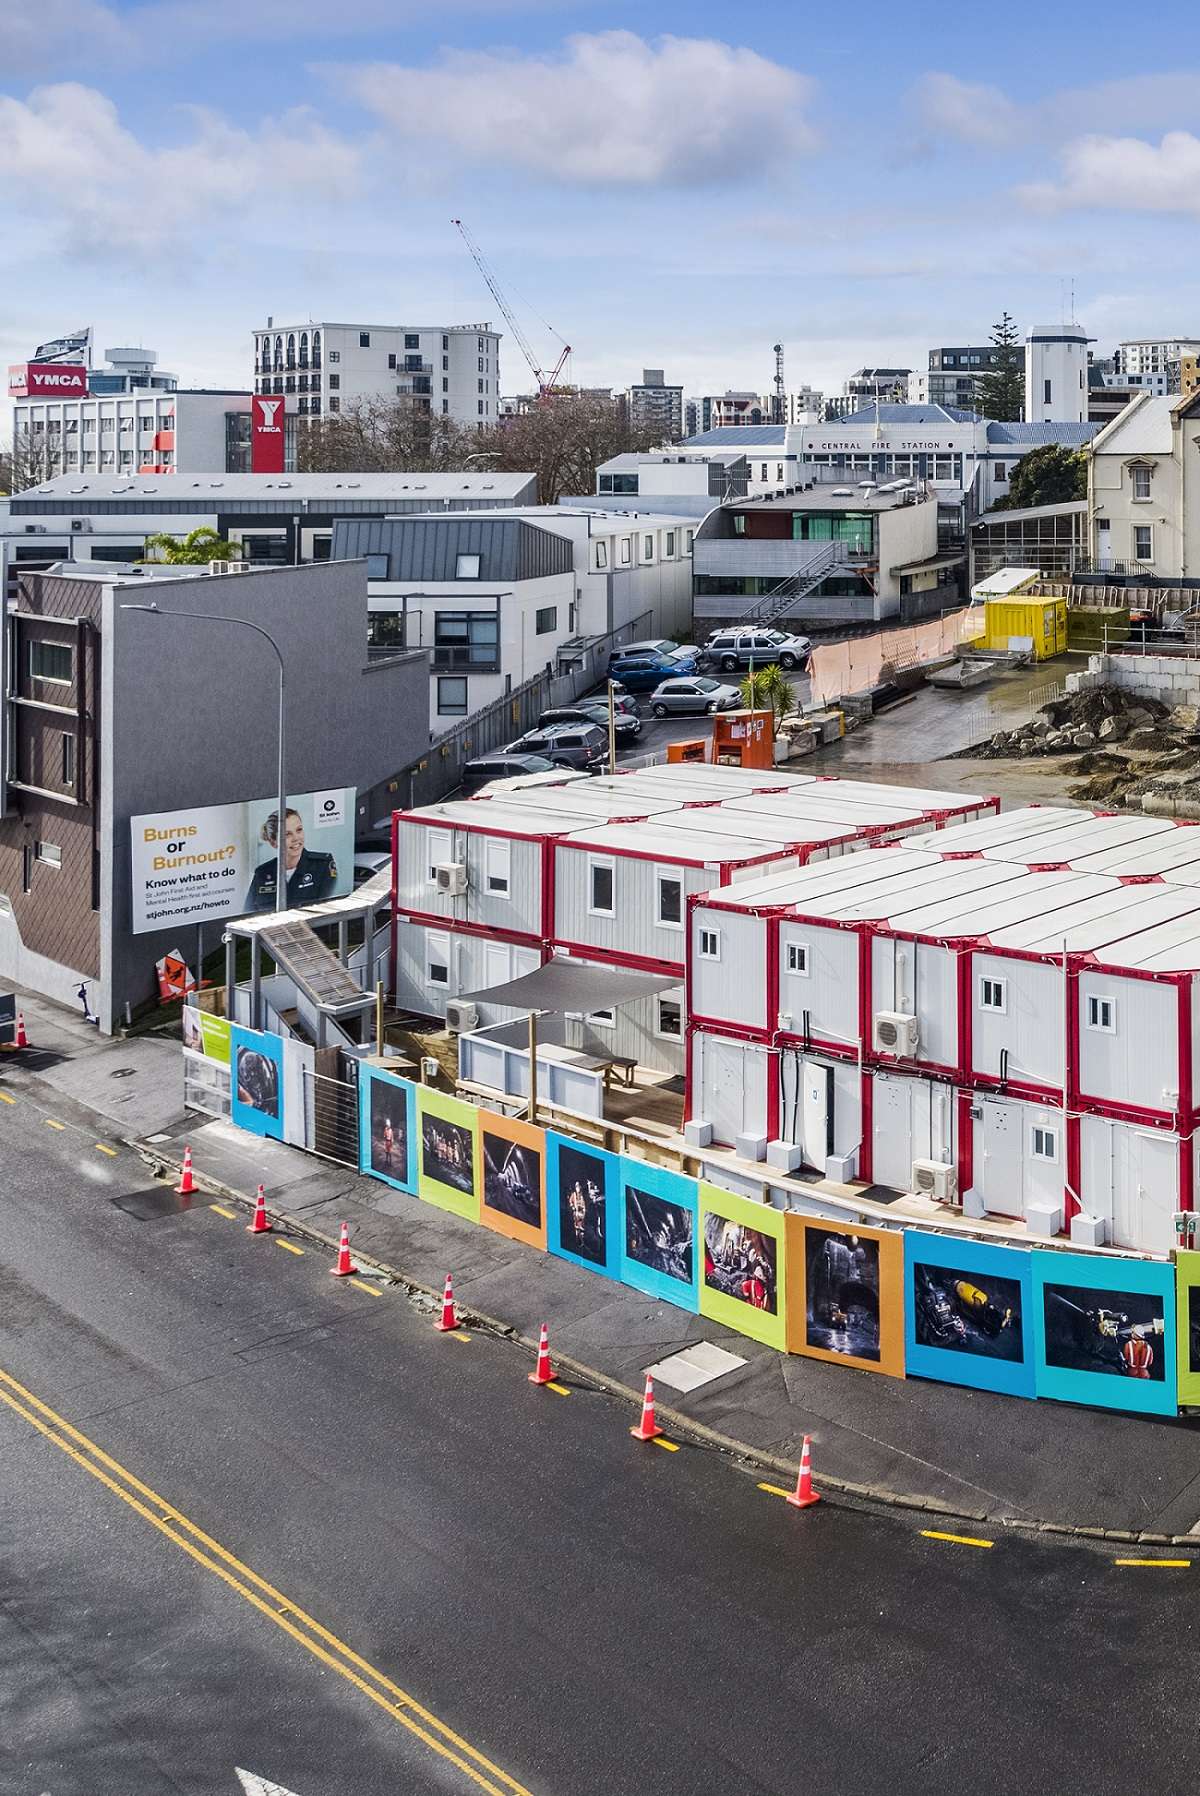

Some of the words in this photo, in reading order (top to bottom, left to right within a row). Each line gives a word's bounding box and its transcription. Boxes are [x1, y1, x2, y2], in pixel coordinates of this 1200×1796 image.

[33, 374, 82, 386] YMCA
[143, 825, 197, 842] Burns
[166, 841, 186, 853] or
[153, 846, 236, 870] Burnout?
[145, 878, 178, 889] Know
[179, 873, 207, 883] what
[209, 871, 220, 879] to
[221, 867, 236, 876] do
[146, 899, 230, 919] stjohn.org.nz/howto
